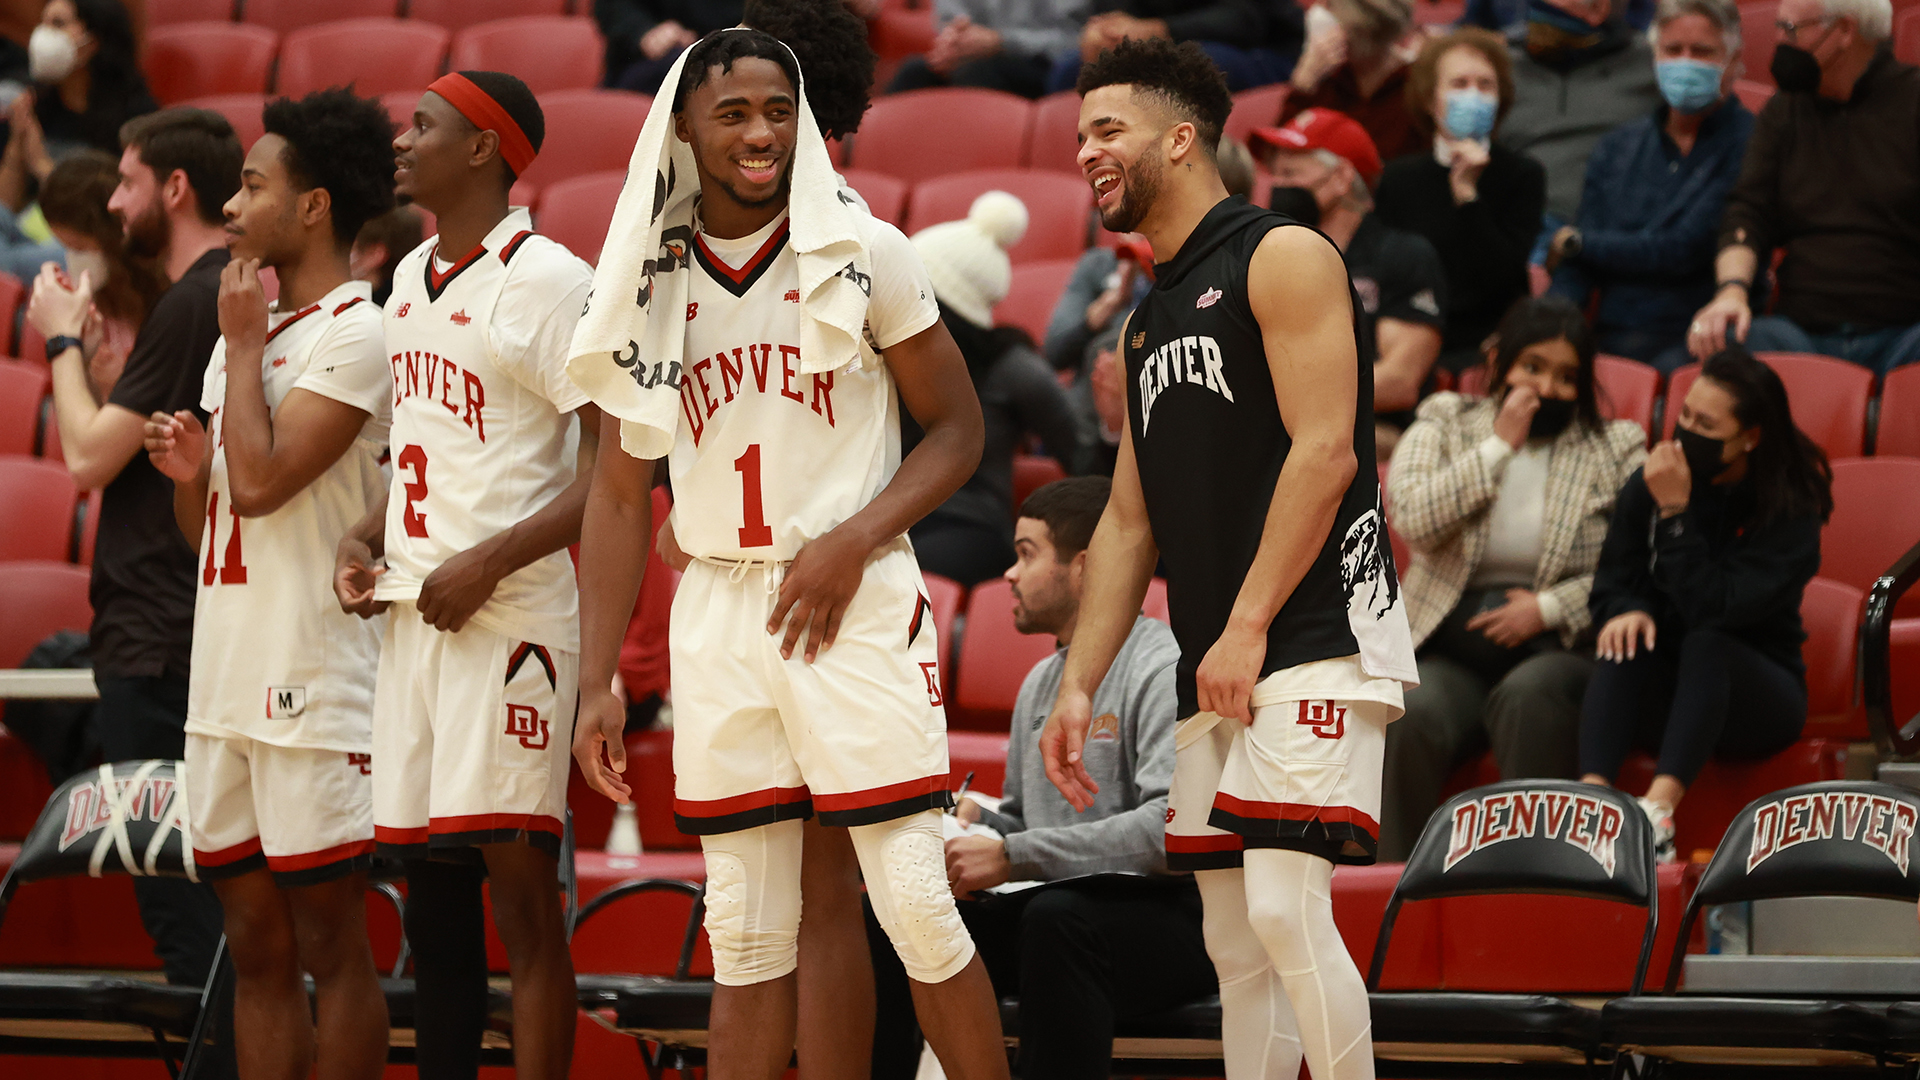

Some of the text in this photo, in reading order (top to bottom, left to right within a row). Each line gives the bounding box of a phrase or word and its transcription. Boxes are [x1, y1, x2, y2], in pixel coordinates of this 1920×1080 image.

[391, 351, 485, 444] ENVER
[1139, 335, 1235, 438] DENVER
[398, 444, 430, 539] 2
[734, 443, 774, 548] 1
[203, 491, 247, 587] 11
[278, 692, 293, 710] M
[504, 703, 549, 750] DU
[1443, 790, 1625, 879] DENVER
[1746, 792, 1918, 878] DENVER
